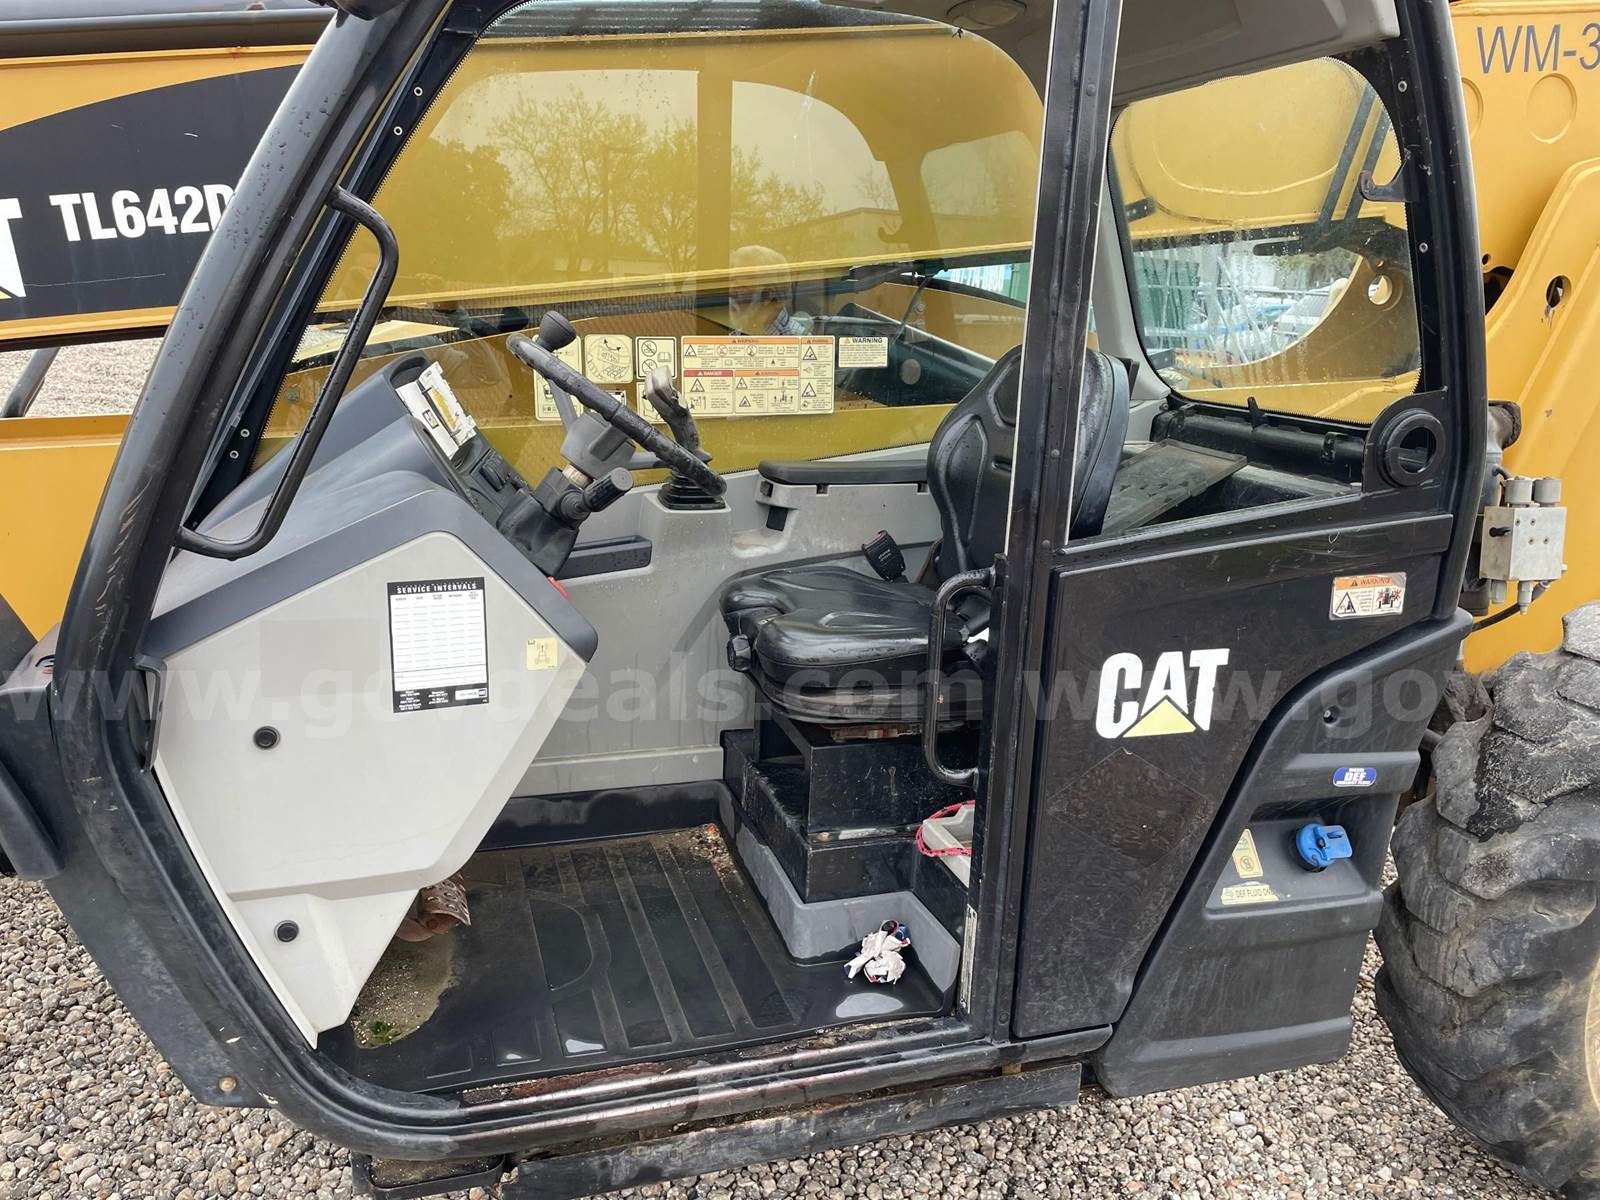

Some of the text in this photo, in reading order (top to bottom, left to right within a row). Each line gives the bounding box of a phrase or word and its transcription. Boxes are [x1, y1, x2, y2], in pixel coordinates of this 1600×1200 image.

[1476, 22, 1600, 74] WM-3
[49, 184, 236, 242] TL642D
[434, 583, 477, 592] INTERVALS
[1095, 648, 1231, 739] CAT
[1344, 772, 1367, 781] DEF
